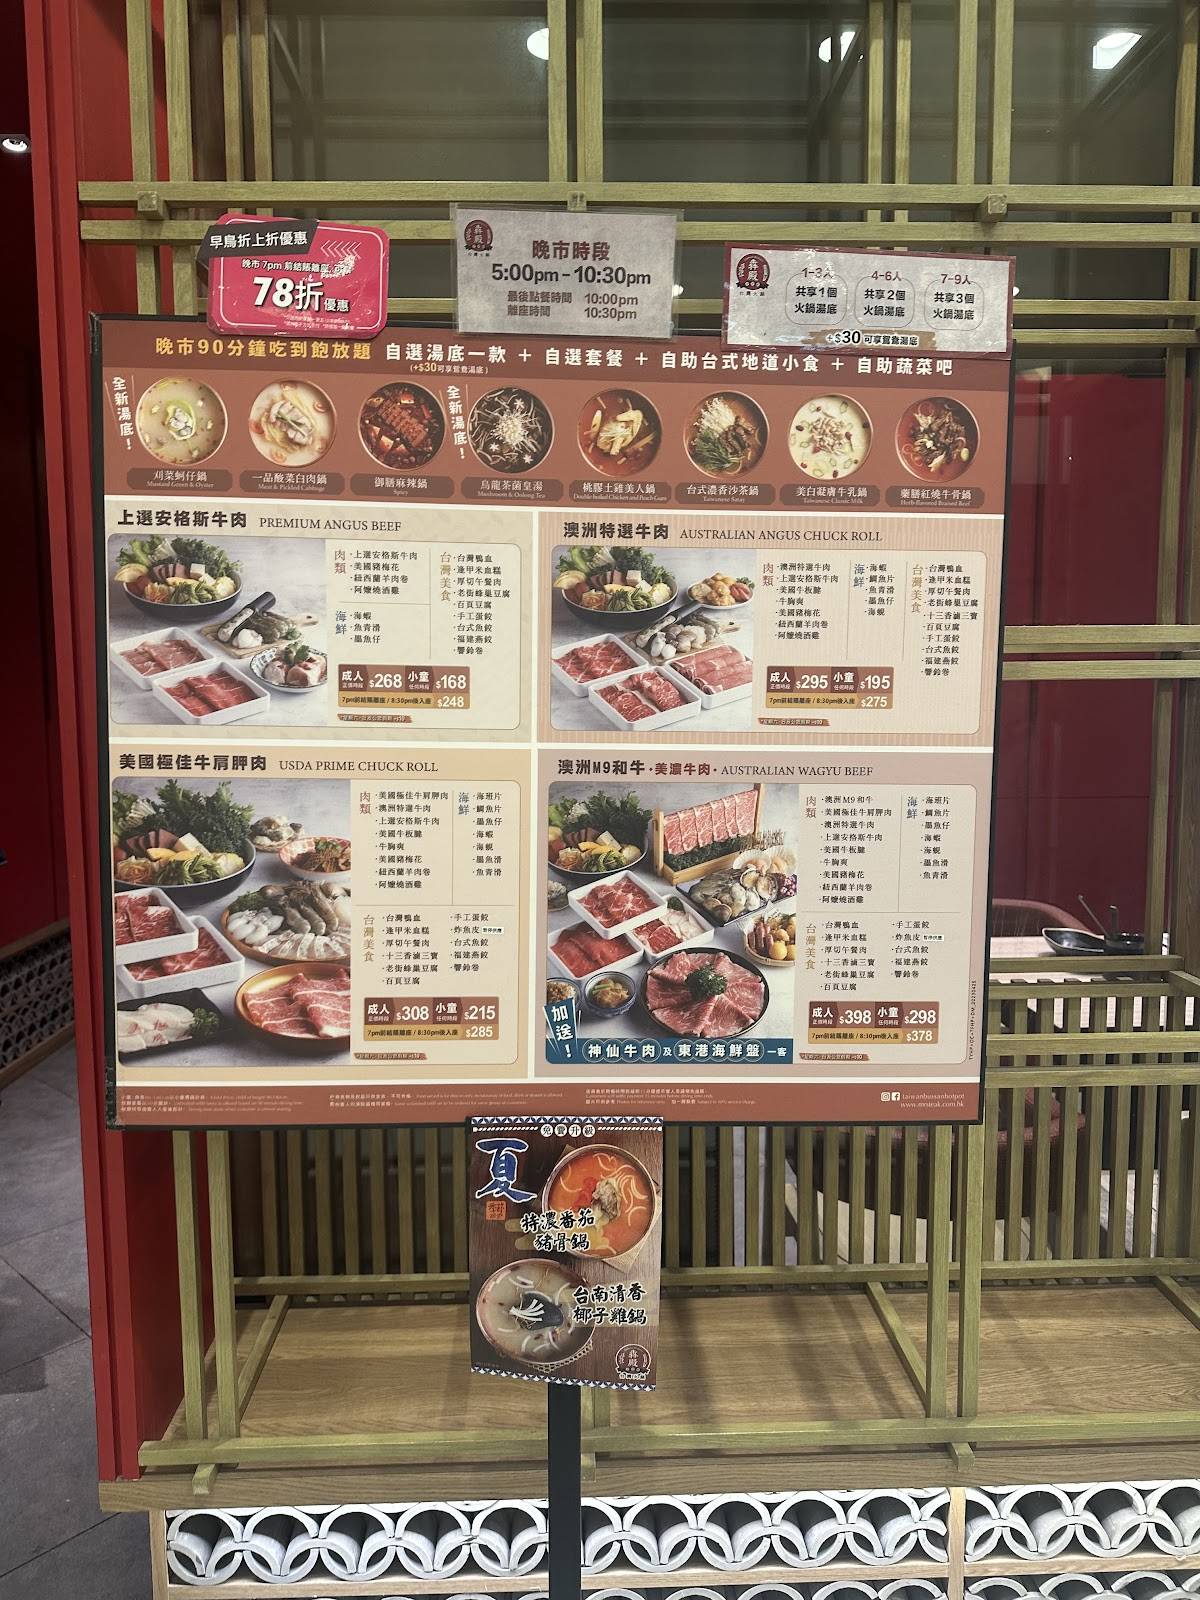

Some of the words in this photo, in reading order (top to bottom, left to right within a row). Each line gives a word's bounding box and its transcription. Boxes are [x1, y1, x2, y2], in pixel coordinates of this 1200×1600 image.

[210, 231, 308, 249] 早鳥折上折優惠
[532, 240, 610, 261] 晚市時段
[262, 260, 282, 271] 7pm
[492, 263, 559, 284] 5:00pm
[574, 265, 651, 287] 10:30pm
[871, 270, 902, 282] 4-6人
[941, 274, 971, 285] 7-9人
[795, 286, 838, 299] 共享1個
[864, 288, 906, 301] 共享2個
[934, 292, 975, 304] 共享3個
[584, 293, 639, 306] 10:00pm
[507, 305, 550, 317] 離座時間
[584, 307, 637, 321] 10:30pm
[795, 303, 837, 315] 火鍋湯底
[863, 305, 905, 317] 火鍋湯底
[933, 307, 975, 320] 火鍋湯底
[155, 337, 372, 360] 晚市90分鐘吃到飽放題
[386, 343, 507, 363] 自選湯底一款
[545, 348, 624, 368] 自選套餐
[661, 351, 819, 374] 自助台式地道小食
[857, 356, 953, 376] 自助蔬菜吧
[153, 470, 208, 482] 刈菜蚵仔鍋
[252, 472, 328, 485] 一品酸菜白肉鍋
[374, 477, 428, 489] 御膳麻辣鍋
[480, 479, 544, 492] 烏龍茶菌皇湯
[687, 484, 759, 496] 台式濃香沙茶鍋
[797, 486, 868, 497] 美白凝膚牛乳鍋
[901, 488, 972, 500] 藥膳紅燒牛骨鍋
[118, 509, 247, 528] 上選安格斯牛肉
[260, 517, 320, 529] PREMIUM
[324, 518, 369, 531] ANGUS
[372, 521, 402, 532] BEEF
[564, 522, 669, 540] 澳洲特選牛肉
[680, 529, 755, 540] AUSTRALIAN
[758, 529, 801, 541] ANGUS
[803, 531, 849, 541] CHUCK
[851, 531, 883, 541] ROLL
[334, 550, 346, 574] 肉類
[353, 550, 418, 561] 上選安格斯牛肉
[335, 610, 347, 635] 海鮮
[342, 670, 364, 682] 成人
[369, 674, 403, 689] $268
[407, 671, 430, 683] 小童
[436, 675, 467, 690] $168
[770, 671, 791, 682] 成人
[796, 675, 828, 690] $295
[834, 672, 854, 683] 小童
[860, 675, 890, 690] $195
[437, 696, 464, 708] $248
[861, 696, 888, 708] $275
[119, 753, 267, 771] 美國極佳牛肩胛肉
[279, 760, 313, 772] USDA
[315, 761, 355, 772] PRIME
[358, 761, 403, 773] CHUCK
[406, 762, 438, 773] ROLL
[721, 766, 795, 776] AUSTRALIAN
[798, 766, 841, 776] WAGYU
[845, 767, 873, 776] BEEF
[360, 792, 371, 815] 肉類
[458, 792, 470, 815] 海鮮
[368, 1003, 390, 1015] 成人
[396, 1005, 429, 1020] $308
[435, 1002, 458, 1014] 小童
[464, 1005, 496, 1020] $215
[812, 1007, 833, 1018] 成人
[839, 1010, 872, 1024] $398
[877, 1007, 899, 1018] 小童
[905, 1010, 937, 1024] $298
[466, 1026, 493, 1038] $285
[907, 1030, 933, 1042] $378
[588, 1044, 656, 1058] 神仙牛肉
[663, 1047, 672, 1056] 及
[678, 1043, 760, 1058] 東港海鮮盤
[767, 1047, 787, 1056] 一客
[541, 1124, 595, 1137] 免費升級
[476, 1138, 537, 1203] 夏
[521, 1208, 595, 1232] 特濃番茄
[534, 1232, 590, 1251] 豬骨鍋
[573, 1282, 646, 1305] 台南清香
[573, 1307, 647, 1327] 椰子雞鍋
